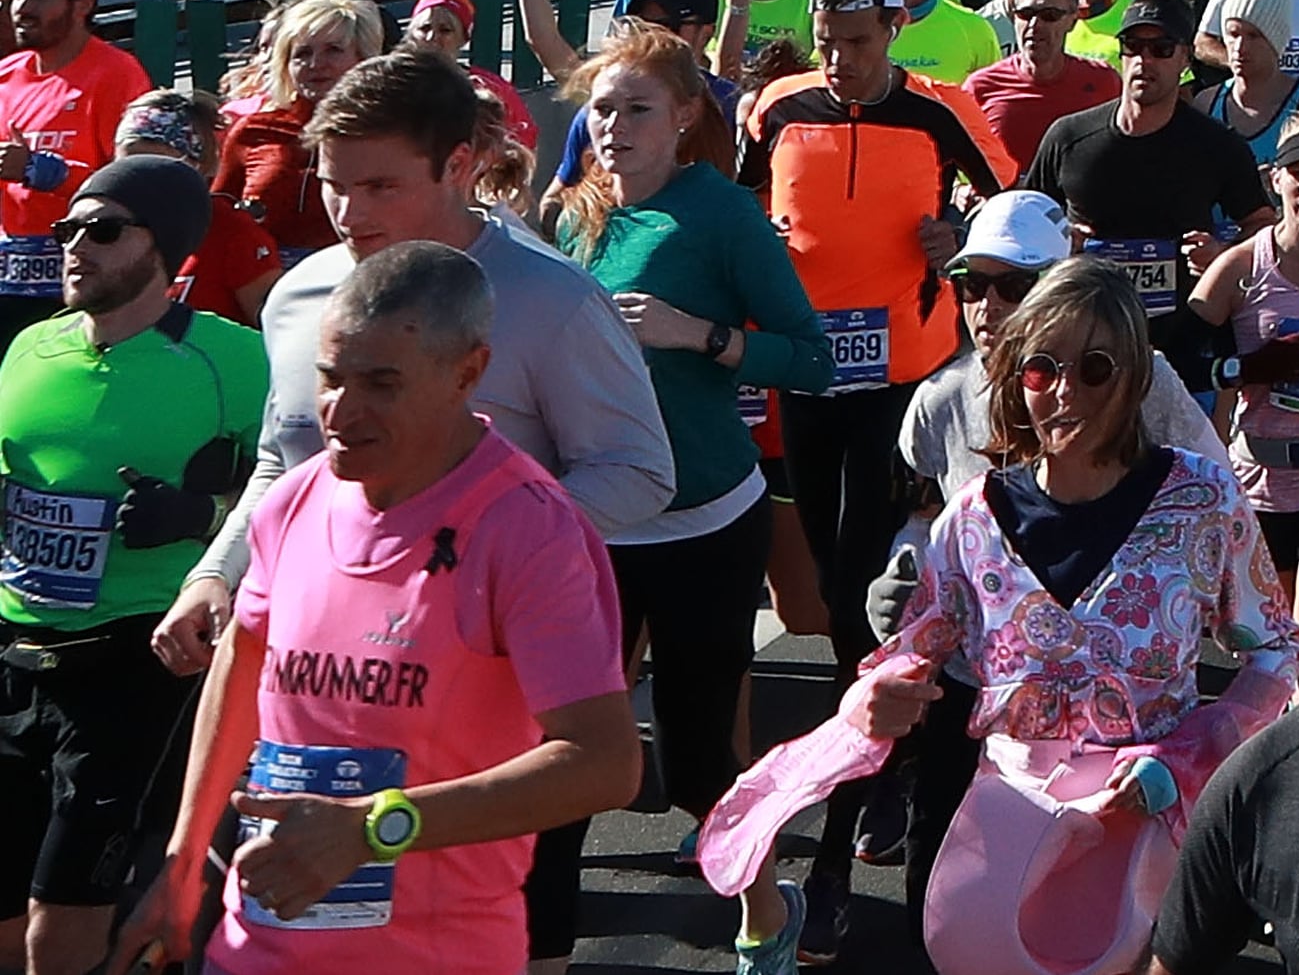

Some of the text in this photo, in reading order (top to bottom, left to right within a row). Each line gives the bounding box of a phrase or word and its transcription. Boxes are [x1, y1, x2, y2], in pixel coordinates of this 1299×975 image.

[1127, 264, 1166, 289] 754
[831, 333, 882, 364] 669
[15, 528, 99, 573] 38505
